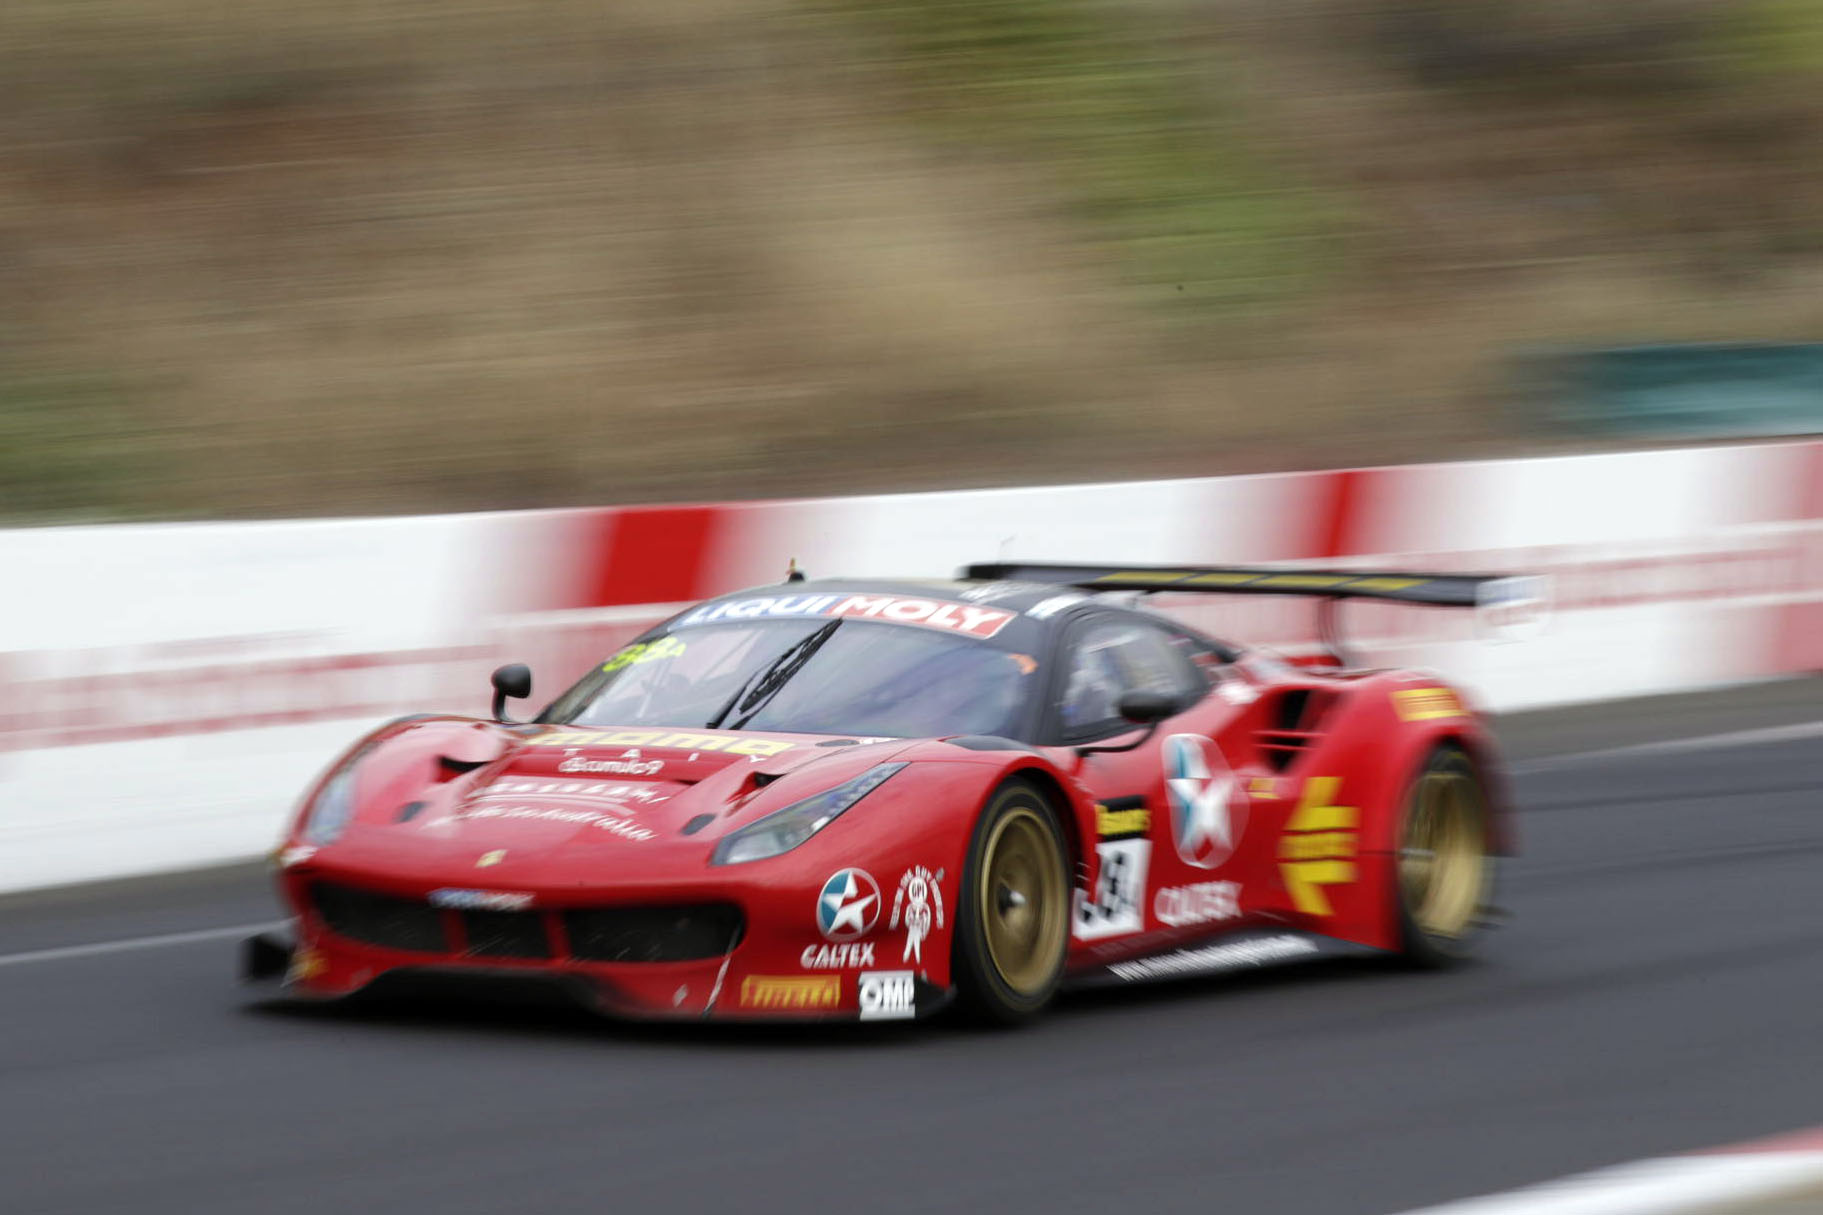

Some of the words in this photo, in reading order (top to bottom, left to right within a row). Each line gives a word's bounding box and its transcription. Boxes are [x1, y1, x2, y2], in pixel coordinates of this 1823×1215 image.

[682, 596, 833, 626] LIQUI
[831, 595, 1004, 632] MOLY
[800, 942, 875, 969] CALTEX
